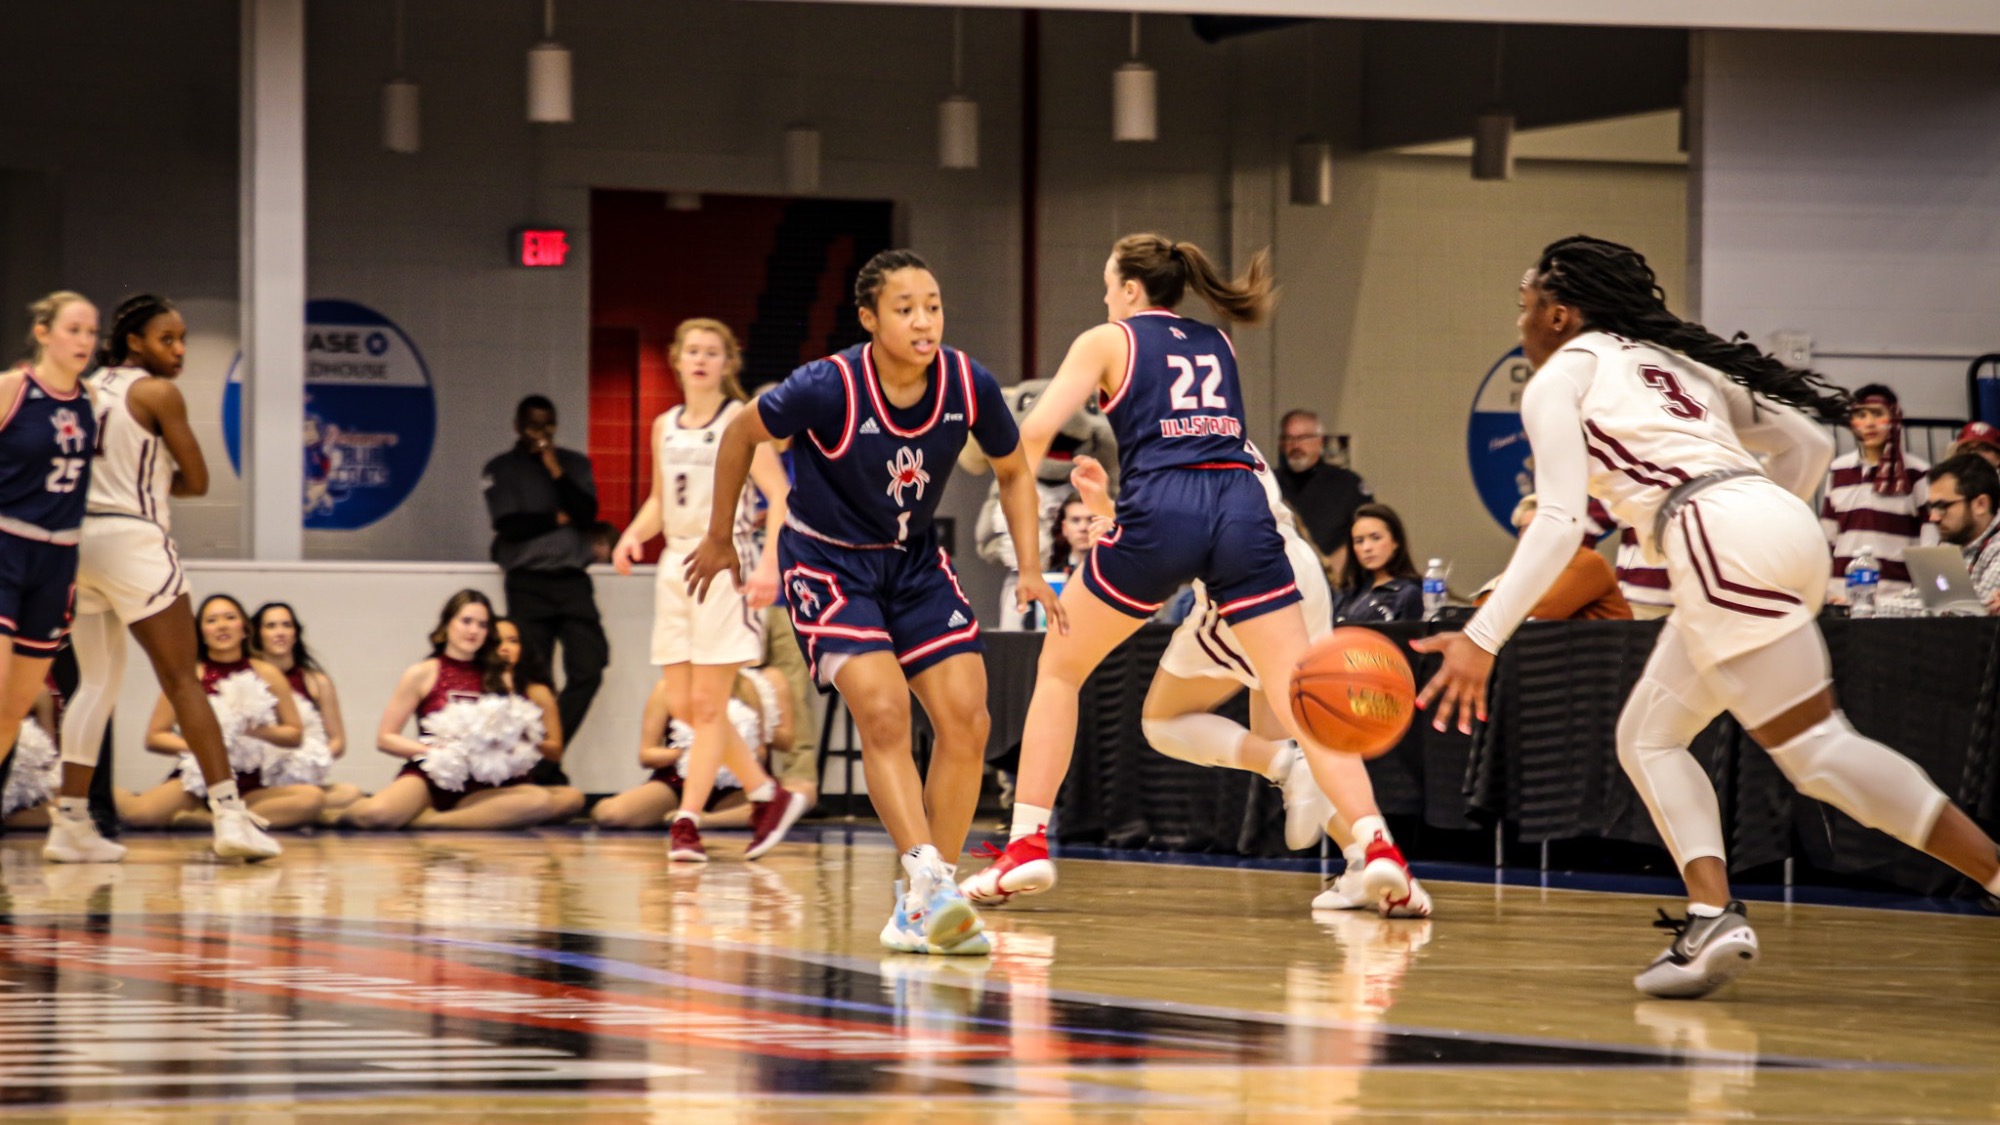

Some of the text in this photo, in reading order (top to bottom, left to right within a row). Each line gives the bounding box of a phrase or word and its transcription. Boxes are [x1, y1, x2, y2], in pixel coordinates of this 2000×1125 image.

[305, 332, 360, 354] ASE
[1166, 353, 1227, 411] 22
[1637, 363, 1708, 422] 3
[45, 457, 86, 494] 25
[896, 510, 912, 541] 1
